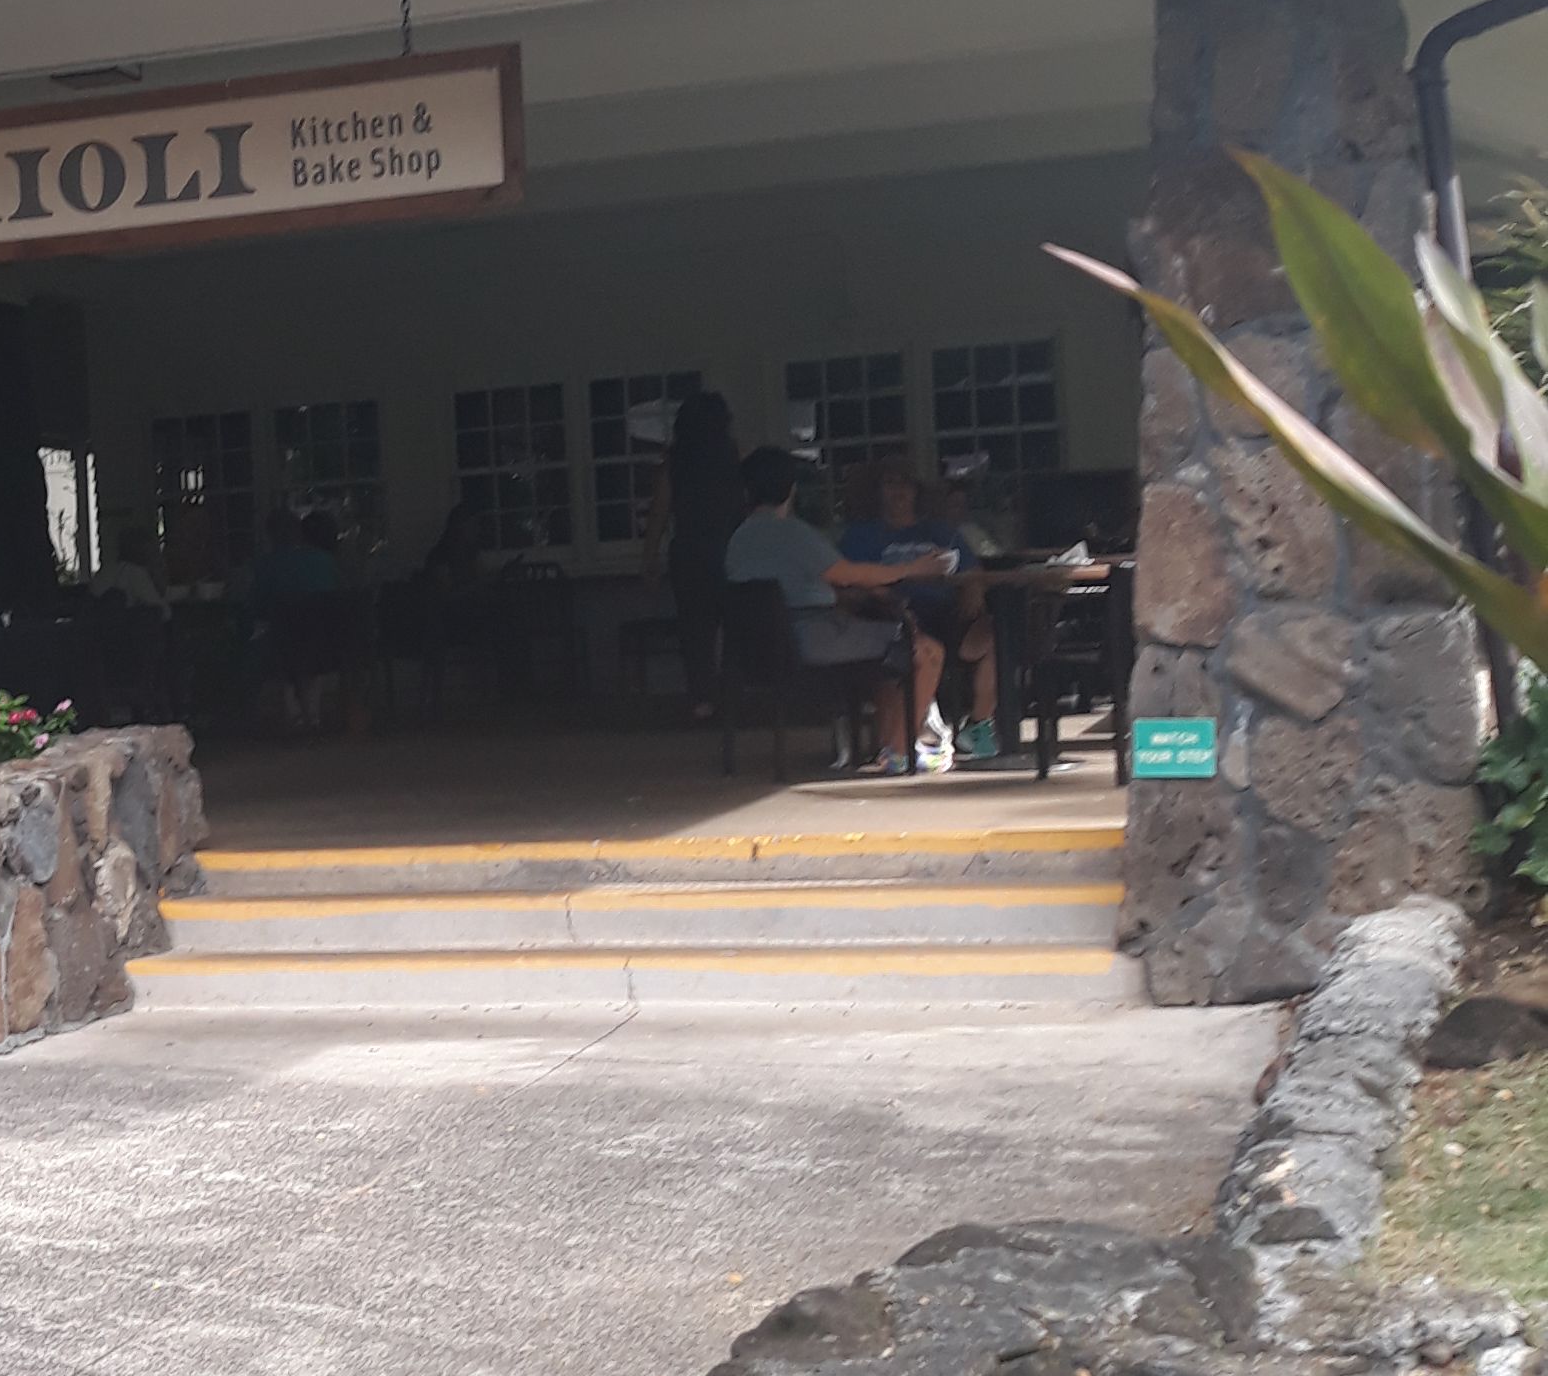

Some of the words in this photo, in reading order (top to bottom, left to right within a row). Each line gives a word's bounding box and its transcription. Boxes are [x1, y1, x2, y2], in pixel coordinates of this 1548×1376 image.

[290, 111, 403, 149] Kitchen
[411, 101, 433, 134] &
[292, 153, 361, 188] Bake
[370, 144, 441, 181] Shop
